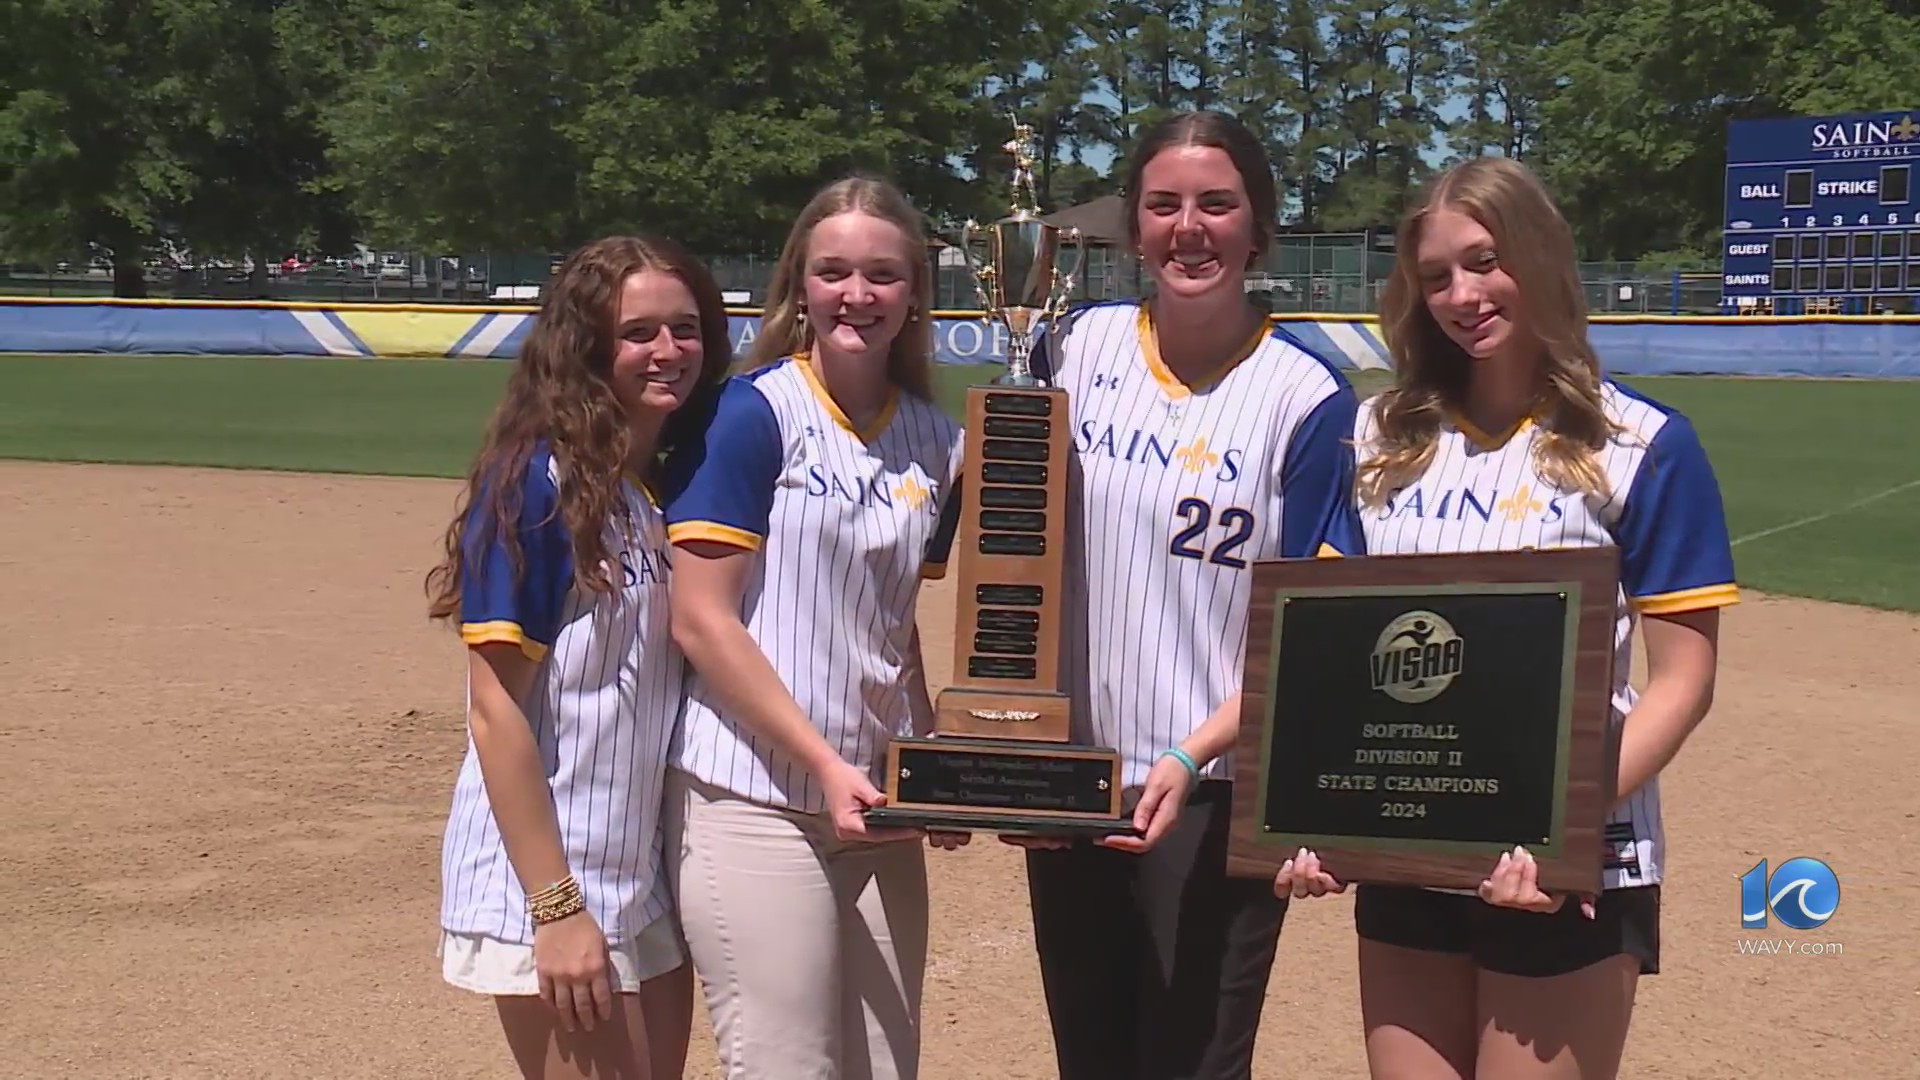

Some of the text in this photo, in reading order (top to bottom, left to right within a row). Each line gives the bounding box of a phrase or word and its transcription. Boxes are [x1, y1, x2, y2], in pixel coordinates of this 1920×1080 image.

[1833, 146, 1911, 159] SOFTBALL
[1740, 180, 1878, 199] BALL STRIKE
[1781, 216, 1790, 228] 1
[1806, 215, 1816, 227] 2
[1832, 214, 1843, 226] 3
[1858, 213, 1869, 225] 4
[1888, 212, 1898, 224] 5
[1728, 244, 1769, 255] GUEST
[1725, 274, 1770, 285] SAINTS
[1169, 497, 1256, 570] 22
[1371, 638, 1462, 688] VISAA
[1362, 723, 1459, 740] SOFTBALL
[1355, 748, 1463, 767] DIVISION II
[1317, 774, 1500, 794] STATE CHAMPIONS
[1380, 802, 1427, 818] 2024
